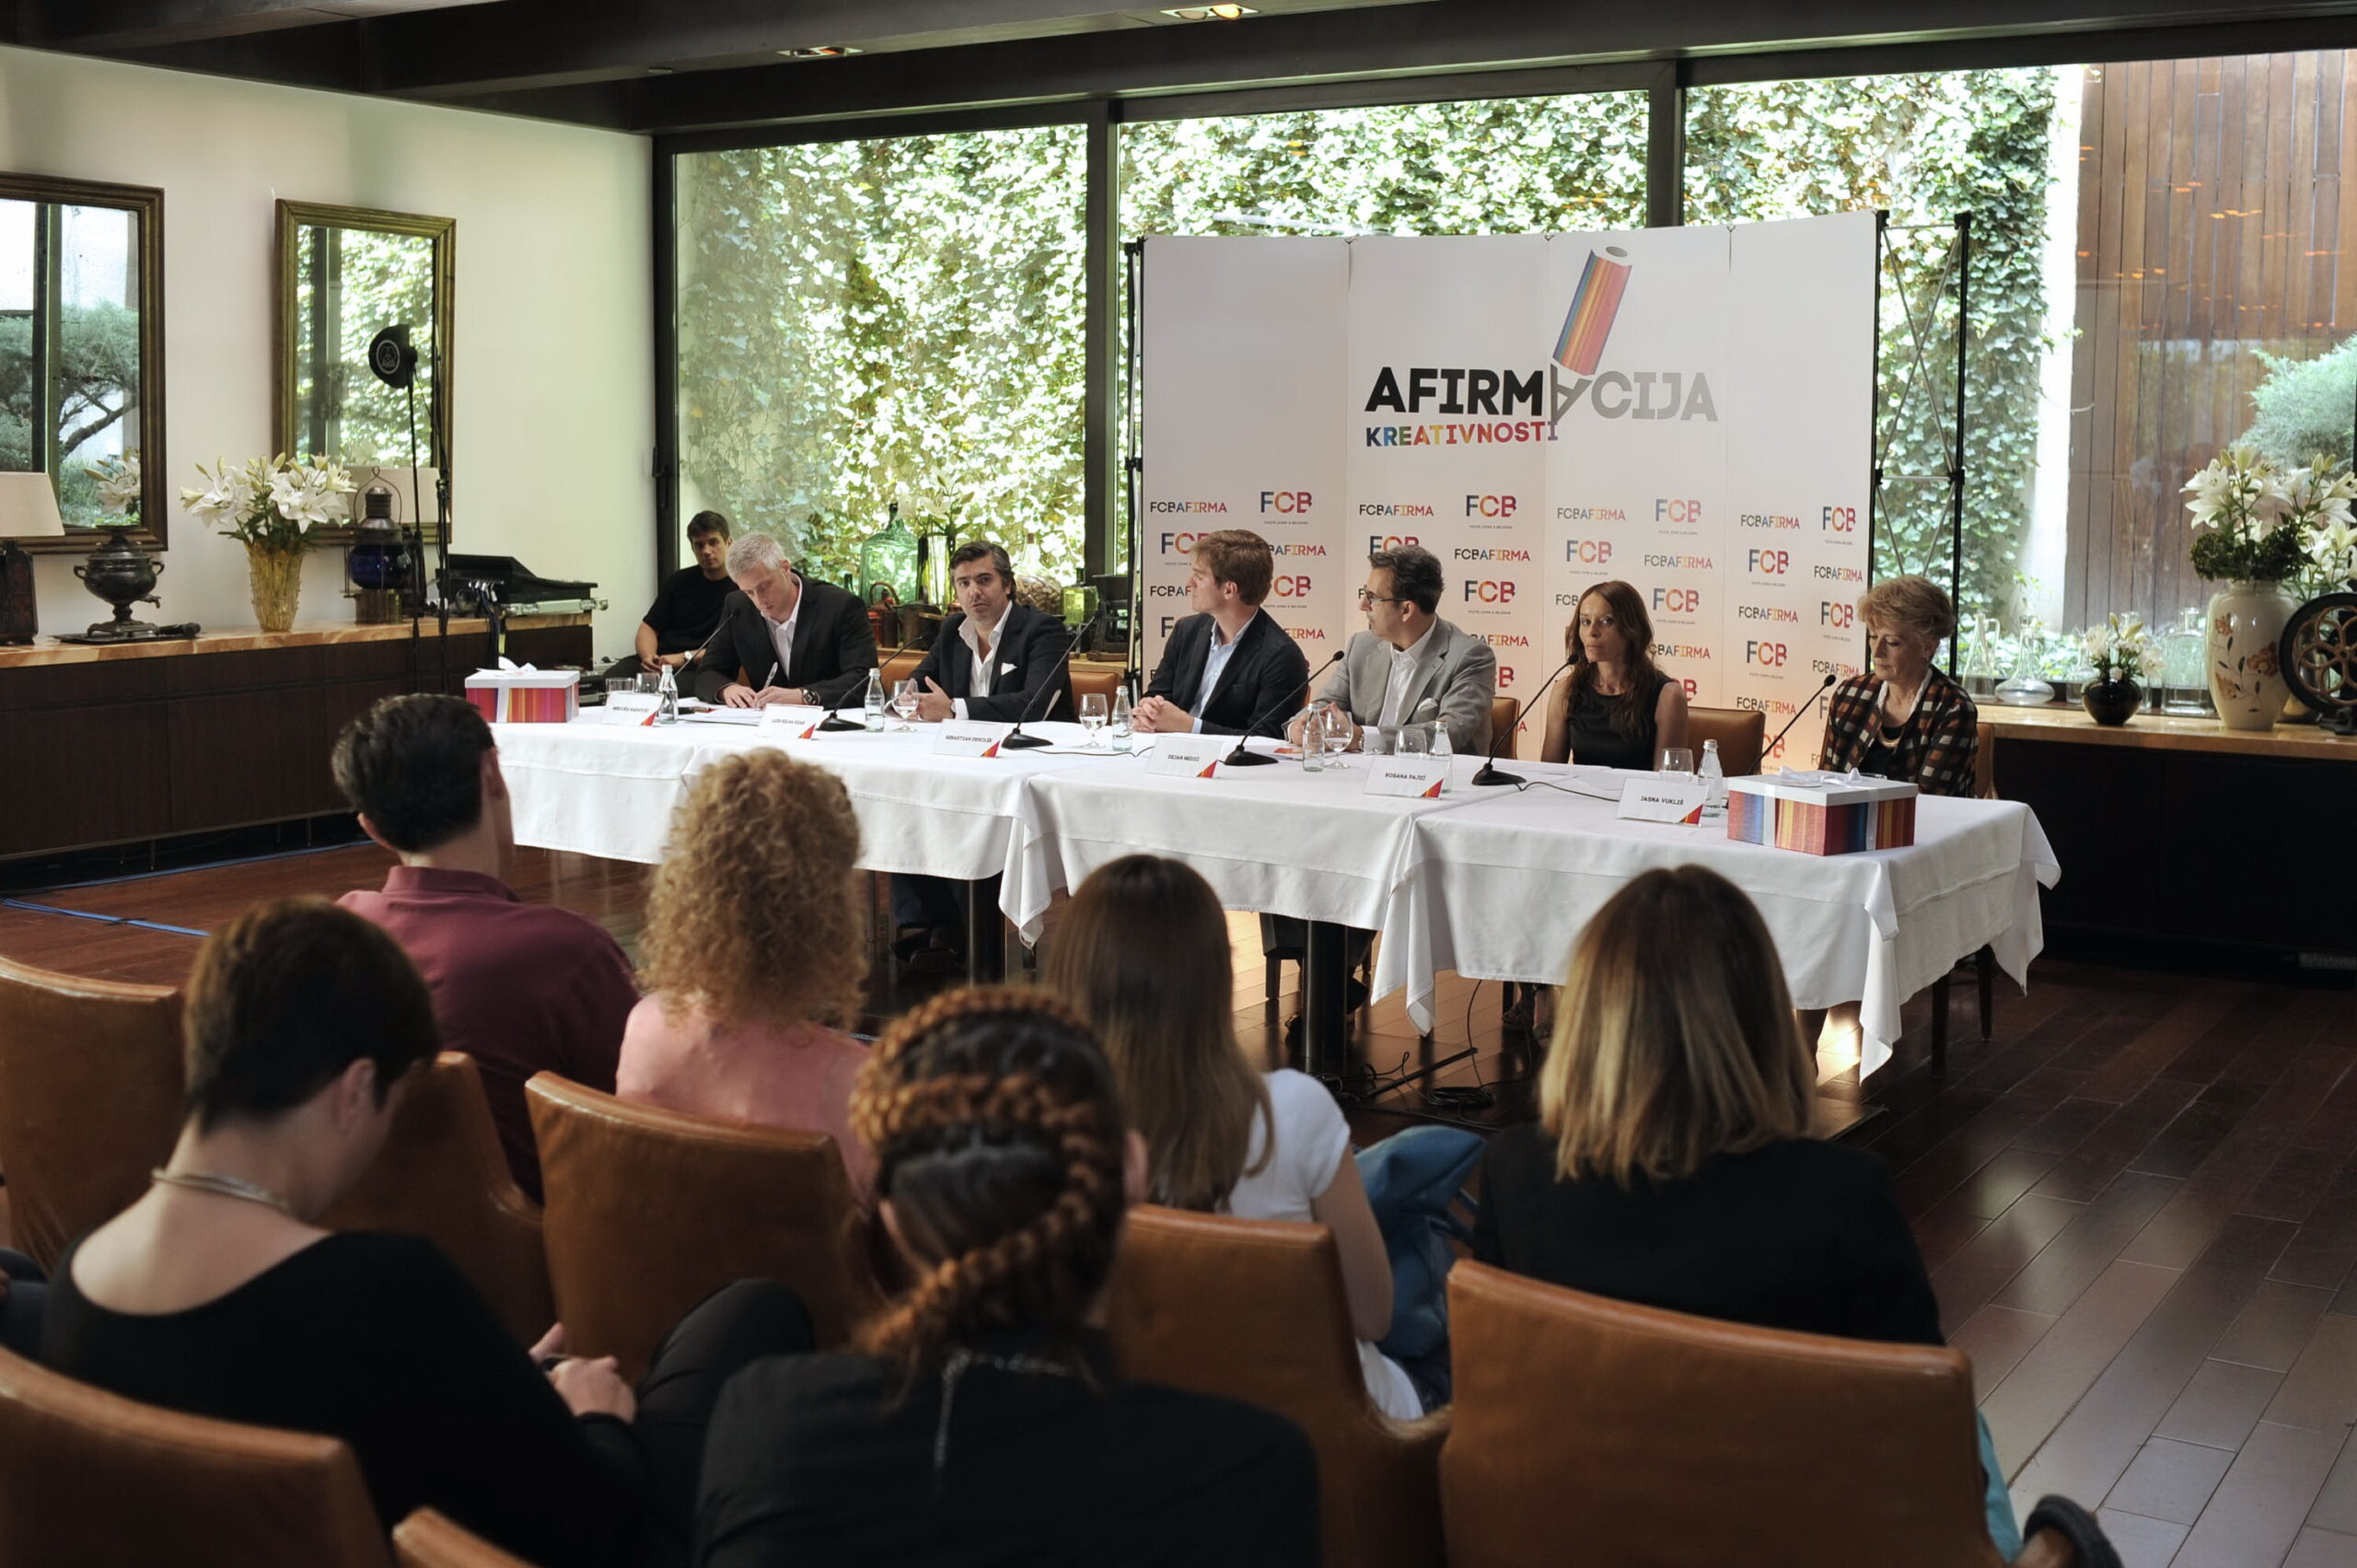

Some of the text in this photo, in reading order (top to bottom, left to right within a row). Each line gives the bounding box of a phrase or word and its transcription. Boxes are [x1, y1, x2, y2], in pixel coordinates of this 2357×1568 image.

[1364, 364, 1718, 424] AFIRMACIJA
[1365, 420, 1559, 447] KREATIVNOSTI
[1150, 502, 1227, 513] FCBAFIRMA
[1260, 492, 1313, 514] FCB
[1359, 504, 1434, 517] FCBAFIRMA
[1466, 494, 1516, 517] FCB
[1557, 507, 1626, 521] FCBAFIRMA
[1655, 499, 1701, 523] FCB
[1741, 515, 1800, 530] FCBAFIRMA
[1823, 506, 1856, 532] FCB
[1161, 532, 1209, 554] FC
[1566, 540, 1612, 563] FCB
[1454, 549, 1530, 562] FCBAFIRMA
[1644, 554, 1713, 569] FCBAFIRMA
[1748, 549, 1789, 575] FCB
[1814, 565, 1863, 583] FCBAFIRMA
[1150, 586, 1192, 597] FCBAF
[1273, 575, 1312, 598] CB
[1464, 580, 1515, 603] FCB
[1653, 587, 1700, 612] FCB
[1739, 606, 1798, 622] FCBAFIRMA
[1821, 600, 1853, 628] FCB
[1649, 644, 1711, 659] CBAFIRMA
[1747, 641, 1787, 667] FCB
[1736, 696, 1796, 715] FCBAFIRMA
